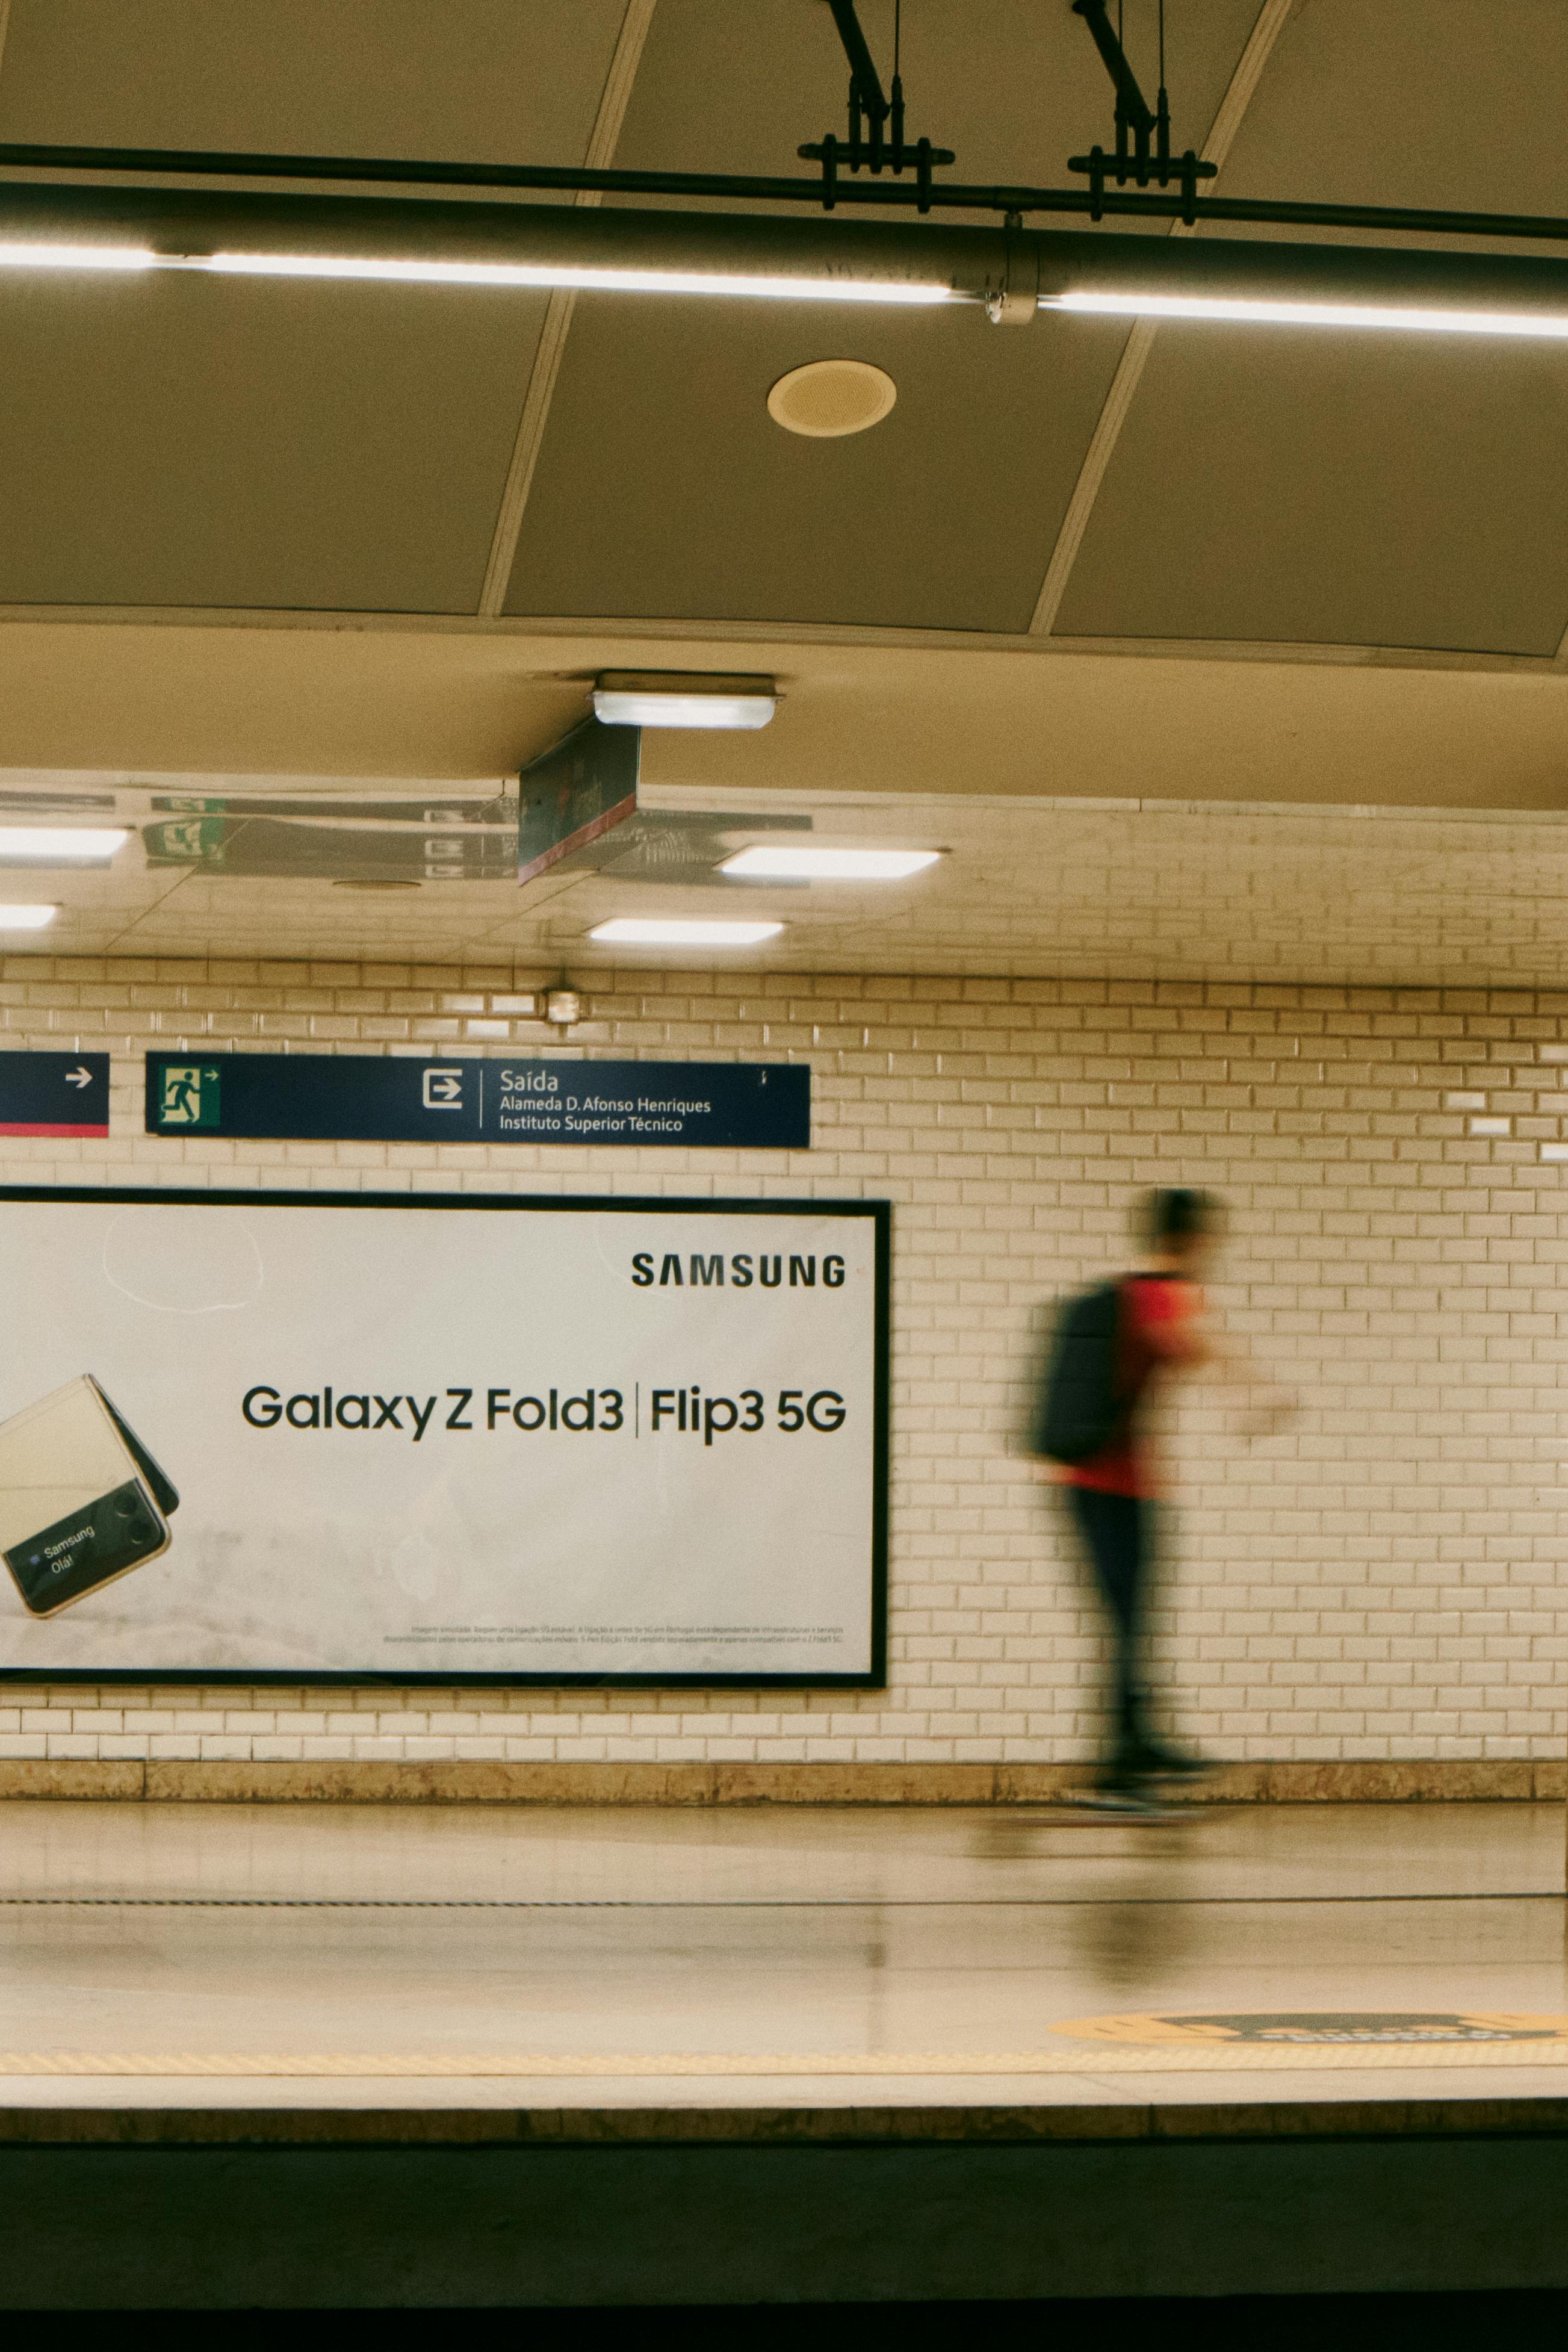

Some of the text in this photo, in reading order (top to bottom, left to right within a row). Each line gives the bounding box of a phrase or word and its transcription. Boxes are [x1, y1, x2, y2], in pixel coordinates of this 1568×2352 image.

[500, 1069, 559, 1092] Saída
[500, 1095, 711, 1116] Alameda D. Afonso Henriques
[500, 1114, 683, 1134] Instituto Superior Técnico
[631, 1252, 846, 1288] SAMSUNG
[241, 1385, 847, 1447] Galaxy Z Fold3 Flip3 5G
[44, 1526, 95, 1559] Samsung
